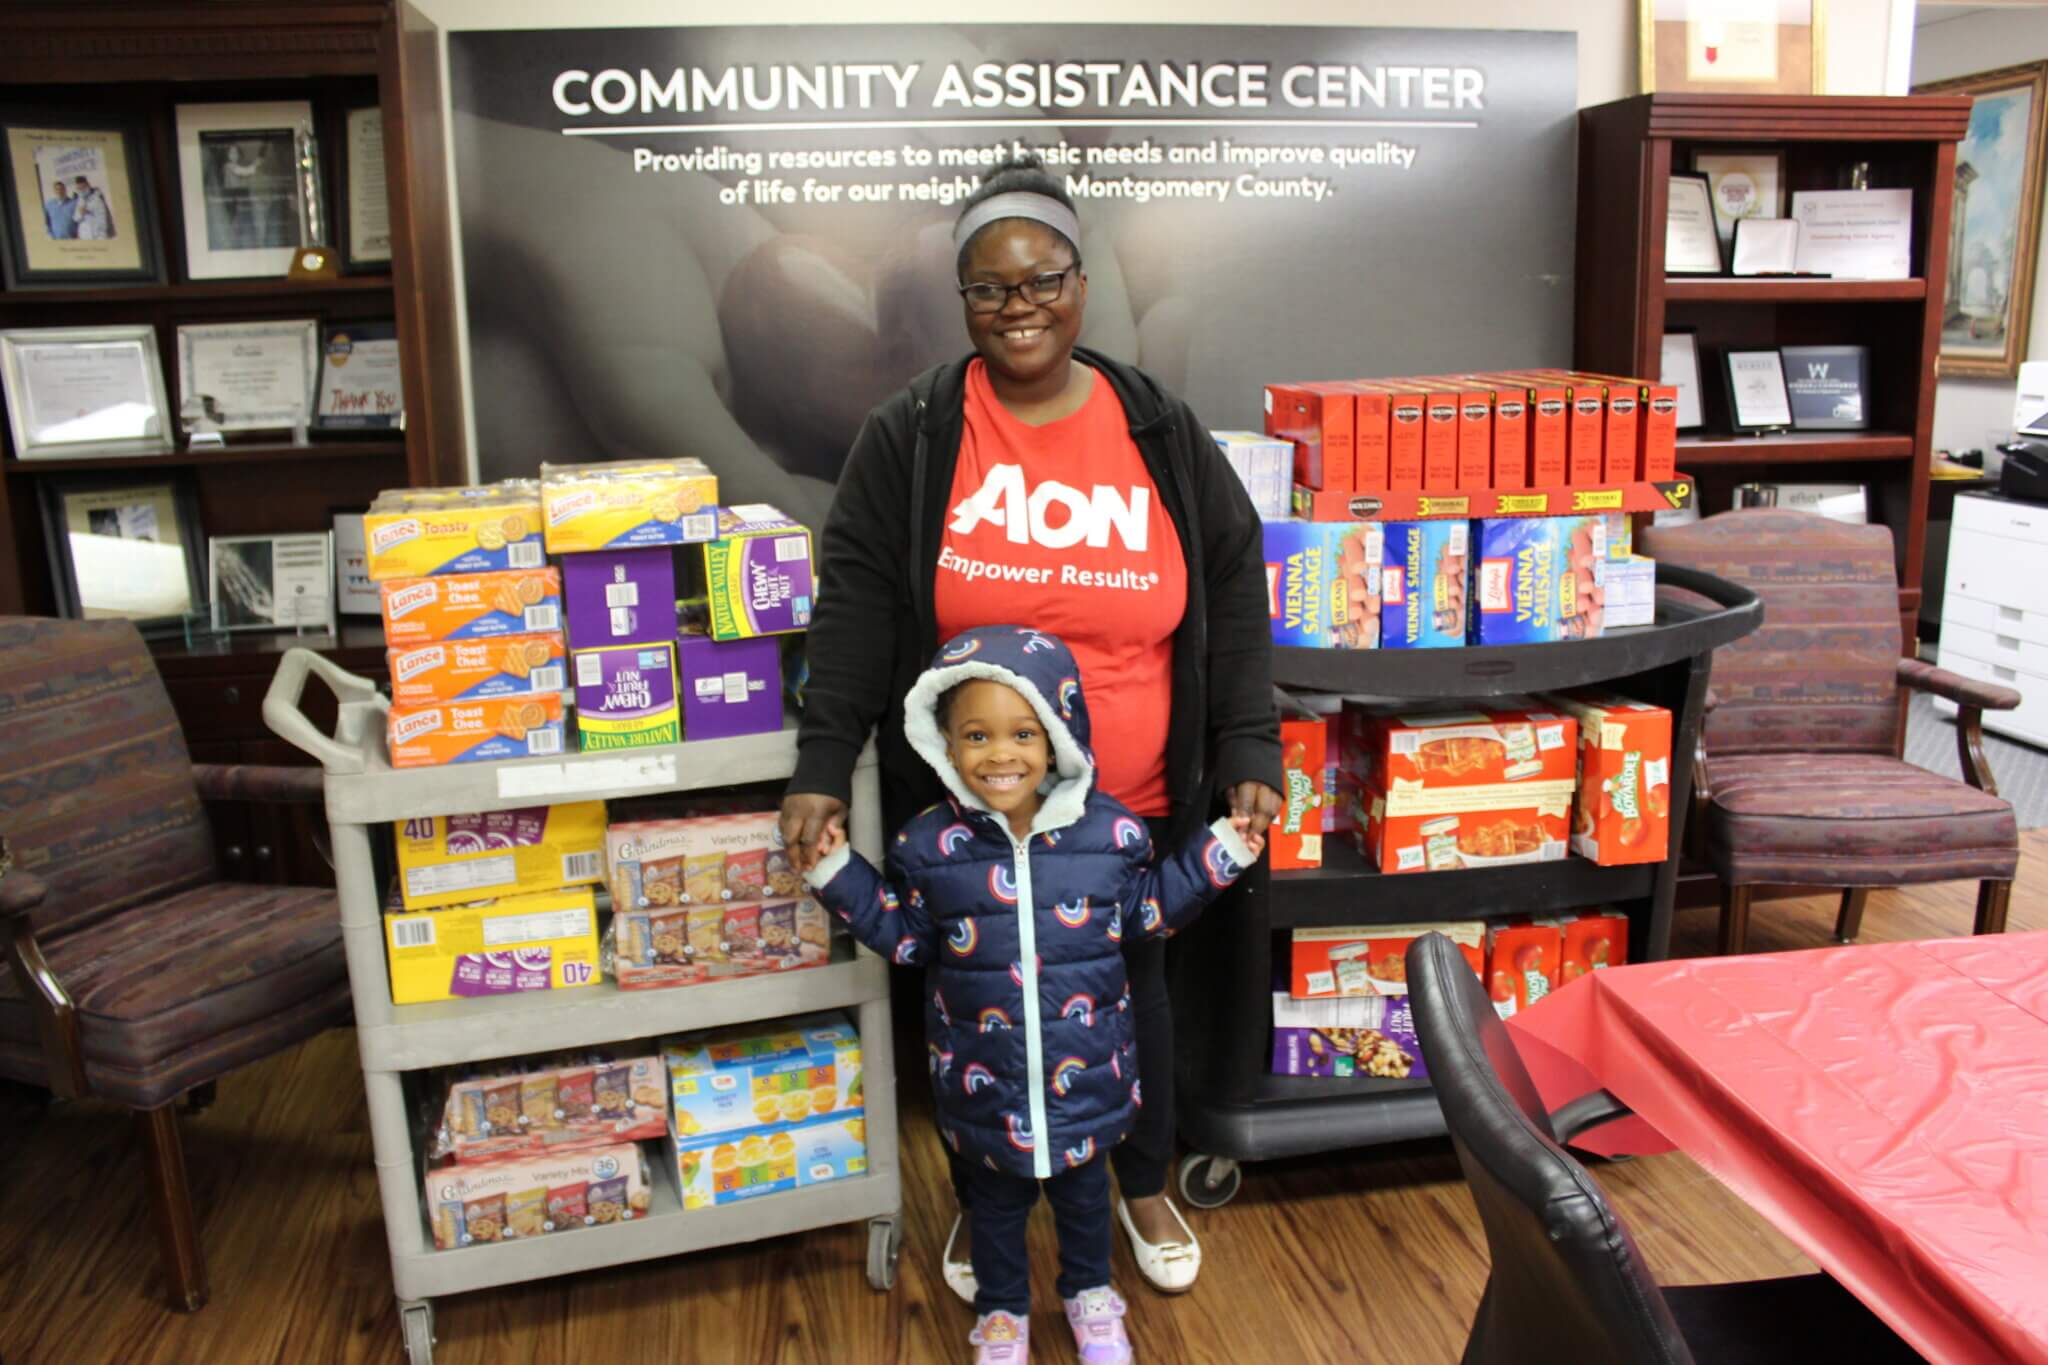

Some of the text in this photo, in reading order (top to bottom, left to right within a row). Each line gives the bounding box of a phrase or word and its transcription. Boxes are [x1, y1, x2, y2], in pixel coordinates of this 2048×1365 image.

[552, 63, 1485, 116] COMMUNITY ASSISTANCE CENTER
[633, 146, 762, 174] Providing
[769, 149, 896, 168] resources
[903, 144, 933, 167] to
[939, 143, 1006, 165] meet
[1087, 141, 1162, 164] needs
[1168, 140, 1217, 164] and
[1223, 141, 1325, 168] improve
[1329, 141, 1416, 169] quality
[719, 180, 750, 205] of
[754, 179, 797, 204] life
[802, 177, 842, 202] for
[848, 181, 894, 201] our
[1065, 174, 1231, 203] Montgomery
[1236, 174, 1334, 202] County.
[1808, 363, 1829, 379] W
[550, 494, 593, 519] Lance
[948, 463, 1150, 552] AON
[1416, 496, 1430, 516] 3
[1496, 495, 1509, 514] 3
[1572, 491, 1586, 511] 3
[373, 520, 470, 545] Lance Toasty
[937, 546, 1053, 583] Empower
[391, 580, 480, 611] Lance Toast
[710, 546, 736, 635] NATURE VALLEY
[750, 560, 770, 611] CHEWY
[769, 576, 782, 608] FRUIT
[779, 574, 791, 599] NUT
[1285, 552, 1304, 629] VIENNA
[1303, 545, 1322, 635] SAUSAGE
[1408, 527, 1421, 643] VIENNA SAUSAGE
[1517, 548, 1534, 623] VIENNA
[1534, 541, 1552, 628] SAUSAGE
[1565, 575, 1573, 616] 18 CANS
[1336, 581, 1346, 624] 18 CANS
[399, 644, 488, 673] Lance Toast
[456, 656, 487, 667] Chee
[614, 671, 640, 682] NUT
[615, 680, 649, 693] FRUIT
[599, 690, 651, 711] CHEWY
[397, 707, 484, 735] Lance Toast
[453, 718, 484, 730] Chee
[626, 724, 673, 746] NATURE
[584, 731, 626, 750] VALLEY
[1622, 751, 1641, 819] BOYARDEE
[1284, 768, 1303, 834] BOYARDEE
[403, 816, 435, 841] 40
[711, 834, 748, 848] Variety
[751, 831, 769, 842] Mix
[563, 961, 593, 985] 40
[1391, 1010, 1402, 1034] NUT
[532, 1169, 569, 1183] Variety
[571, 1165, 589, 1176] Mix
[597, 1159, 615, 1170] 36
